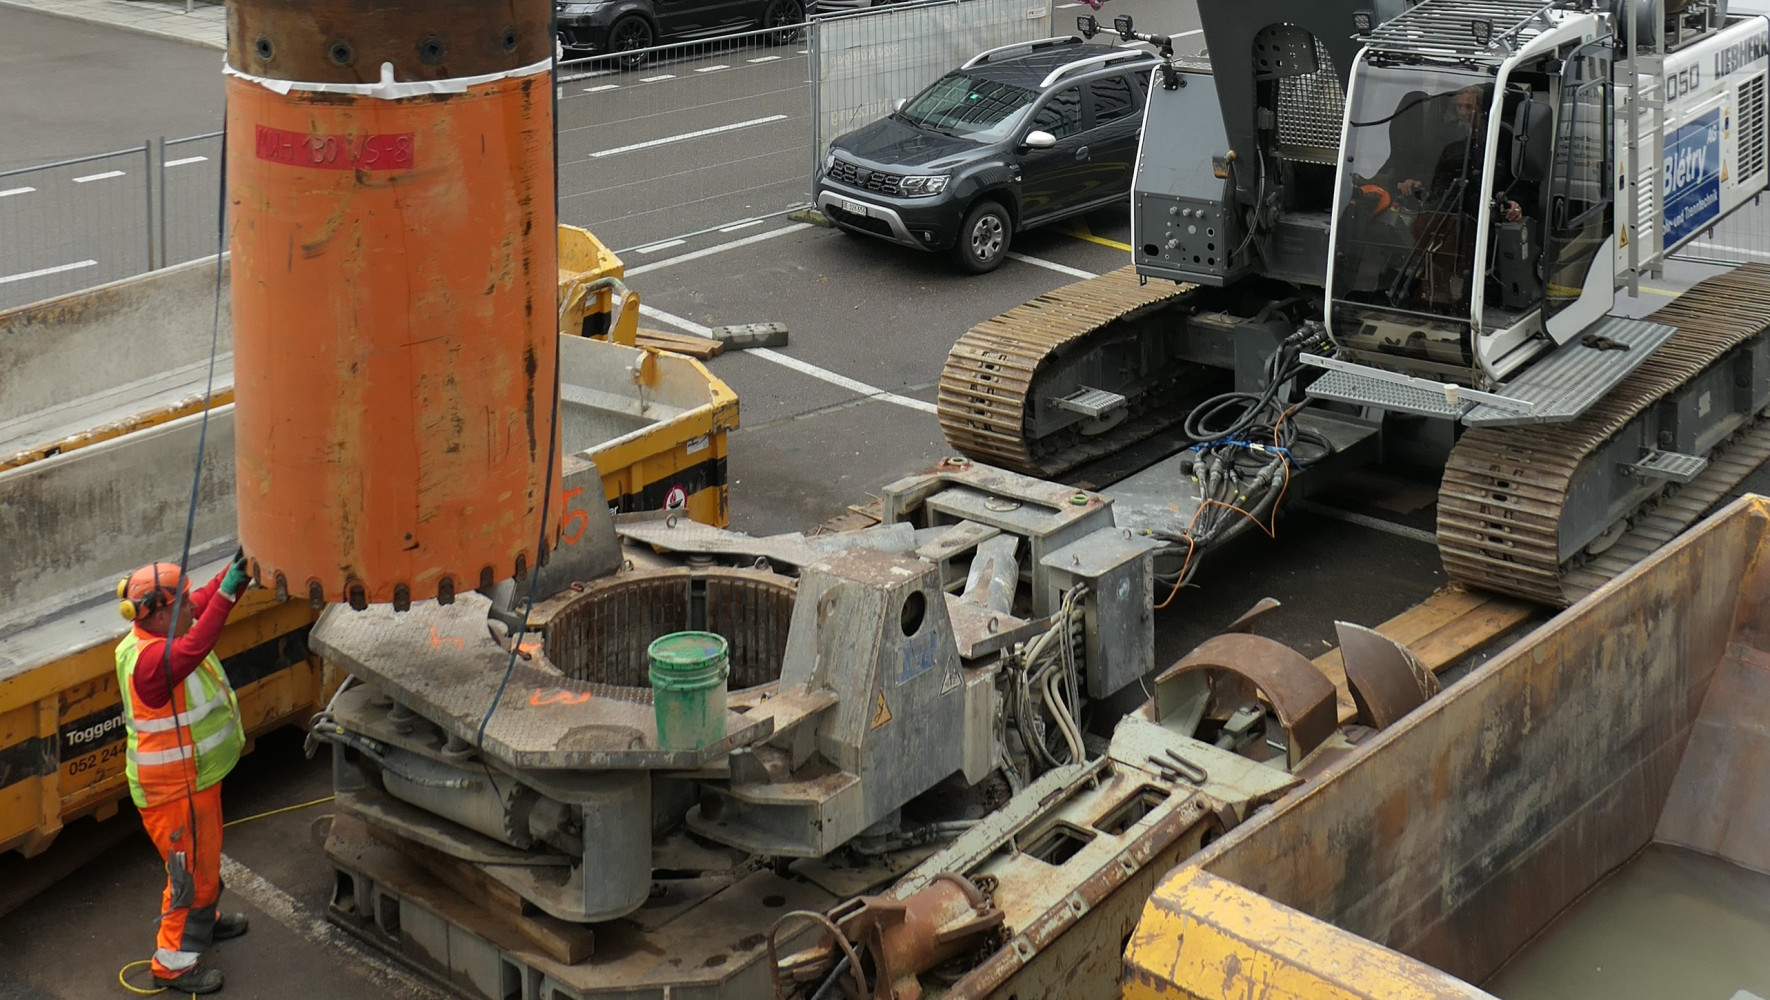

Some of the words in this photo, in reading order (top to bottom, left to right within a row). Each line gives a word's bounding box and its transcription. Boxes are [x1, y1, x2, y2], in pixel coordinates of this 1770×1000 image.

[1667, 62, 1699, 102] 050
[1663, 145, 1707, 197] Blétry
[69, 755, 97, 776] 052
